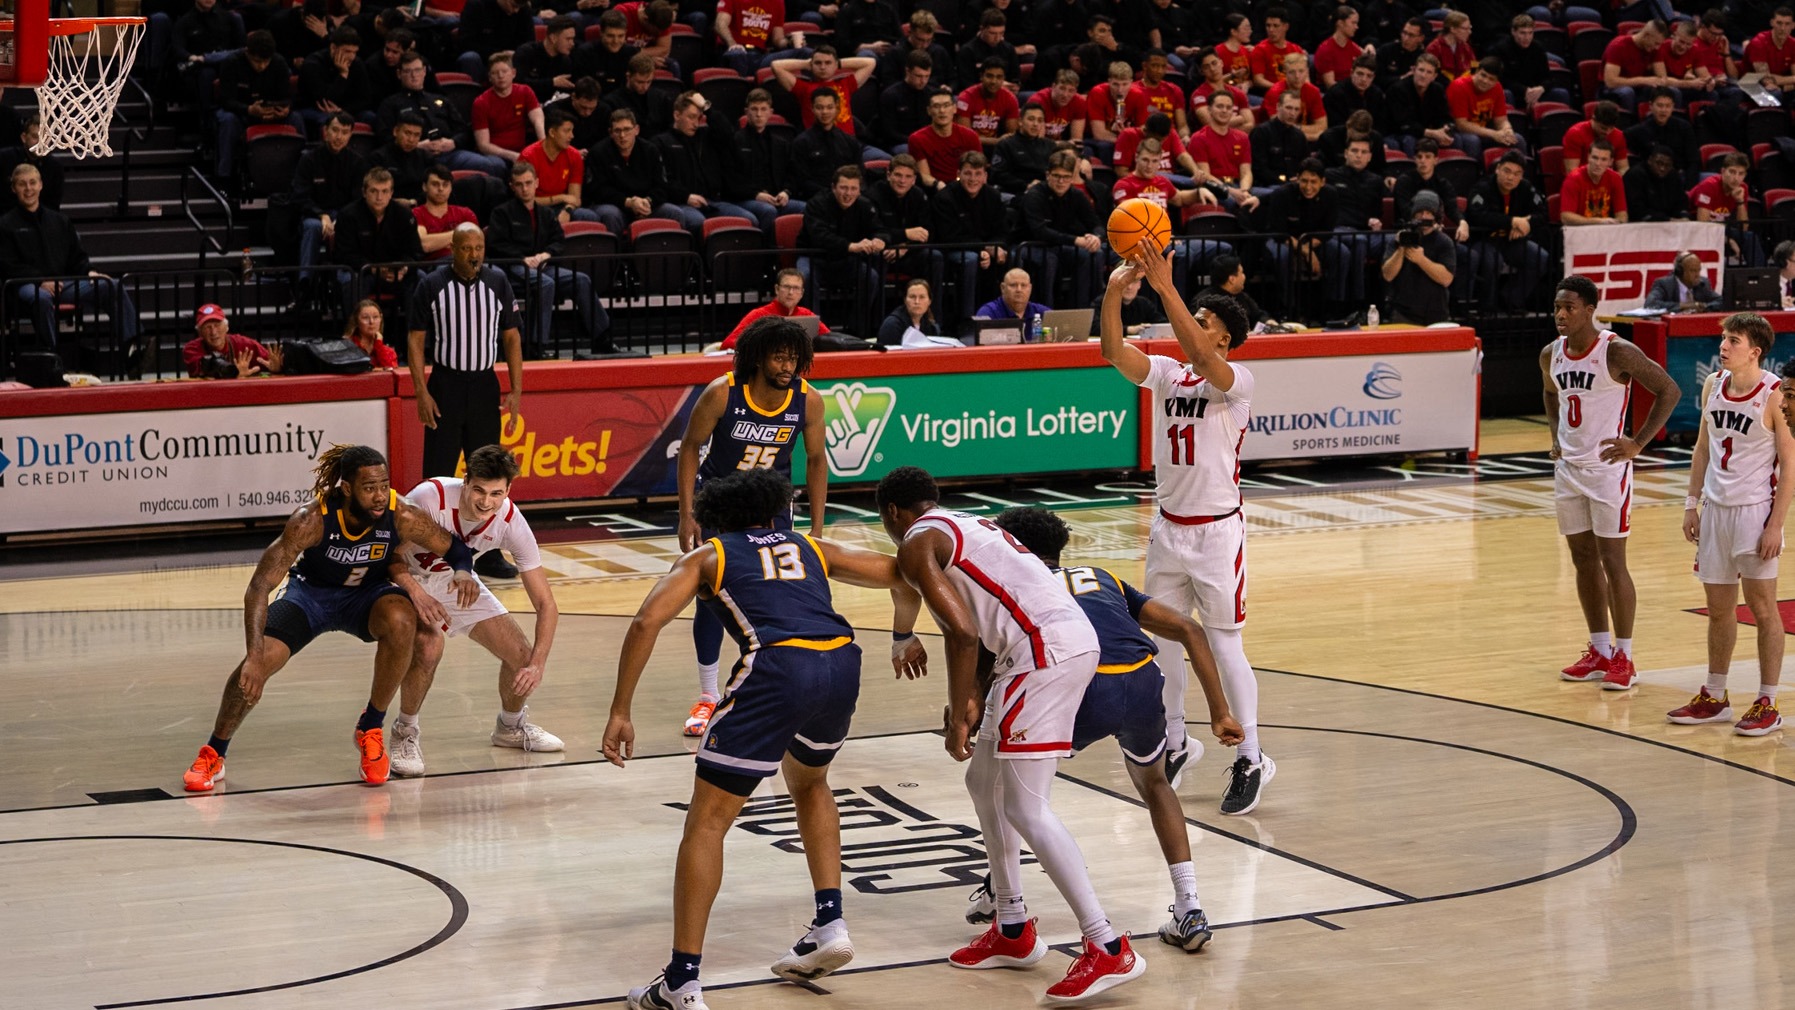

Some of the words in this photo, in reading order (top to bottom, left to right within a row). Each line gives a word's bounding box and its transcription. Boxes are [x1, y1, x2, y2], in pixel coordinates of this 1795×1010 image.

[1556, 371, 1595, 390] VMI
[1165, 397, 1209, 419] VMI
[1567, 395, 1583, 428] 0
[731, 421, 795, 444] UNCG
[901, 410, 1016, 447] Virginia
[1027, 406, 1127, 438] Lottery
[1248, 412, 1328, 435] ARILION
[1711, 410, 1754, 435] VMI
[1167, 424, 1196, 466] 11
[1292, 437, 1338, 450] SPORTS
[1342, 434, 1401, 447] MEDICINE
[454, 431, 612, 478] dets!
[736, 445, 780, 471] 35
[1721, 437, 1734, 471] 1
[17, 470, 89, 486] CREDIT
[103, 466, 168, 481] UNION
[140, 496, 219, 515] mydccu.com
[746, 532, 787, 544] JONES
[325, 542, 388, 564] UNCG
[757, 542, 807, 580] 13
[343, 567, 369, 586] 2
